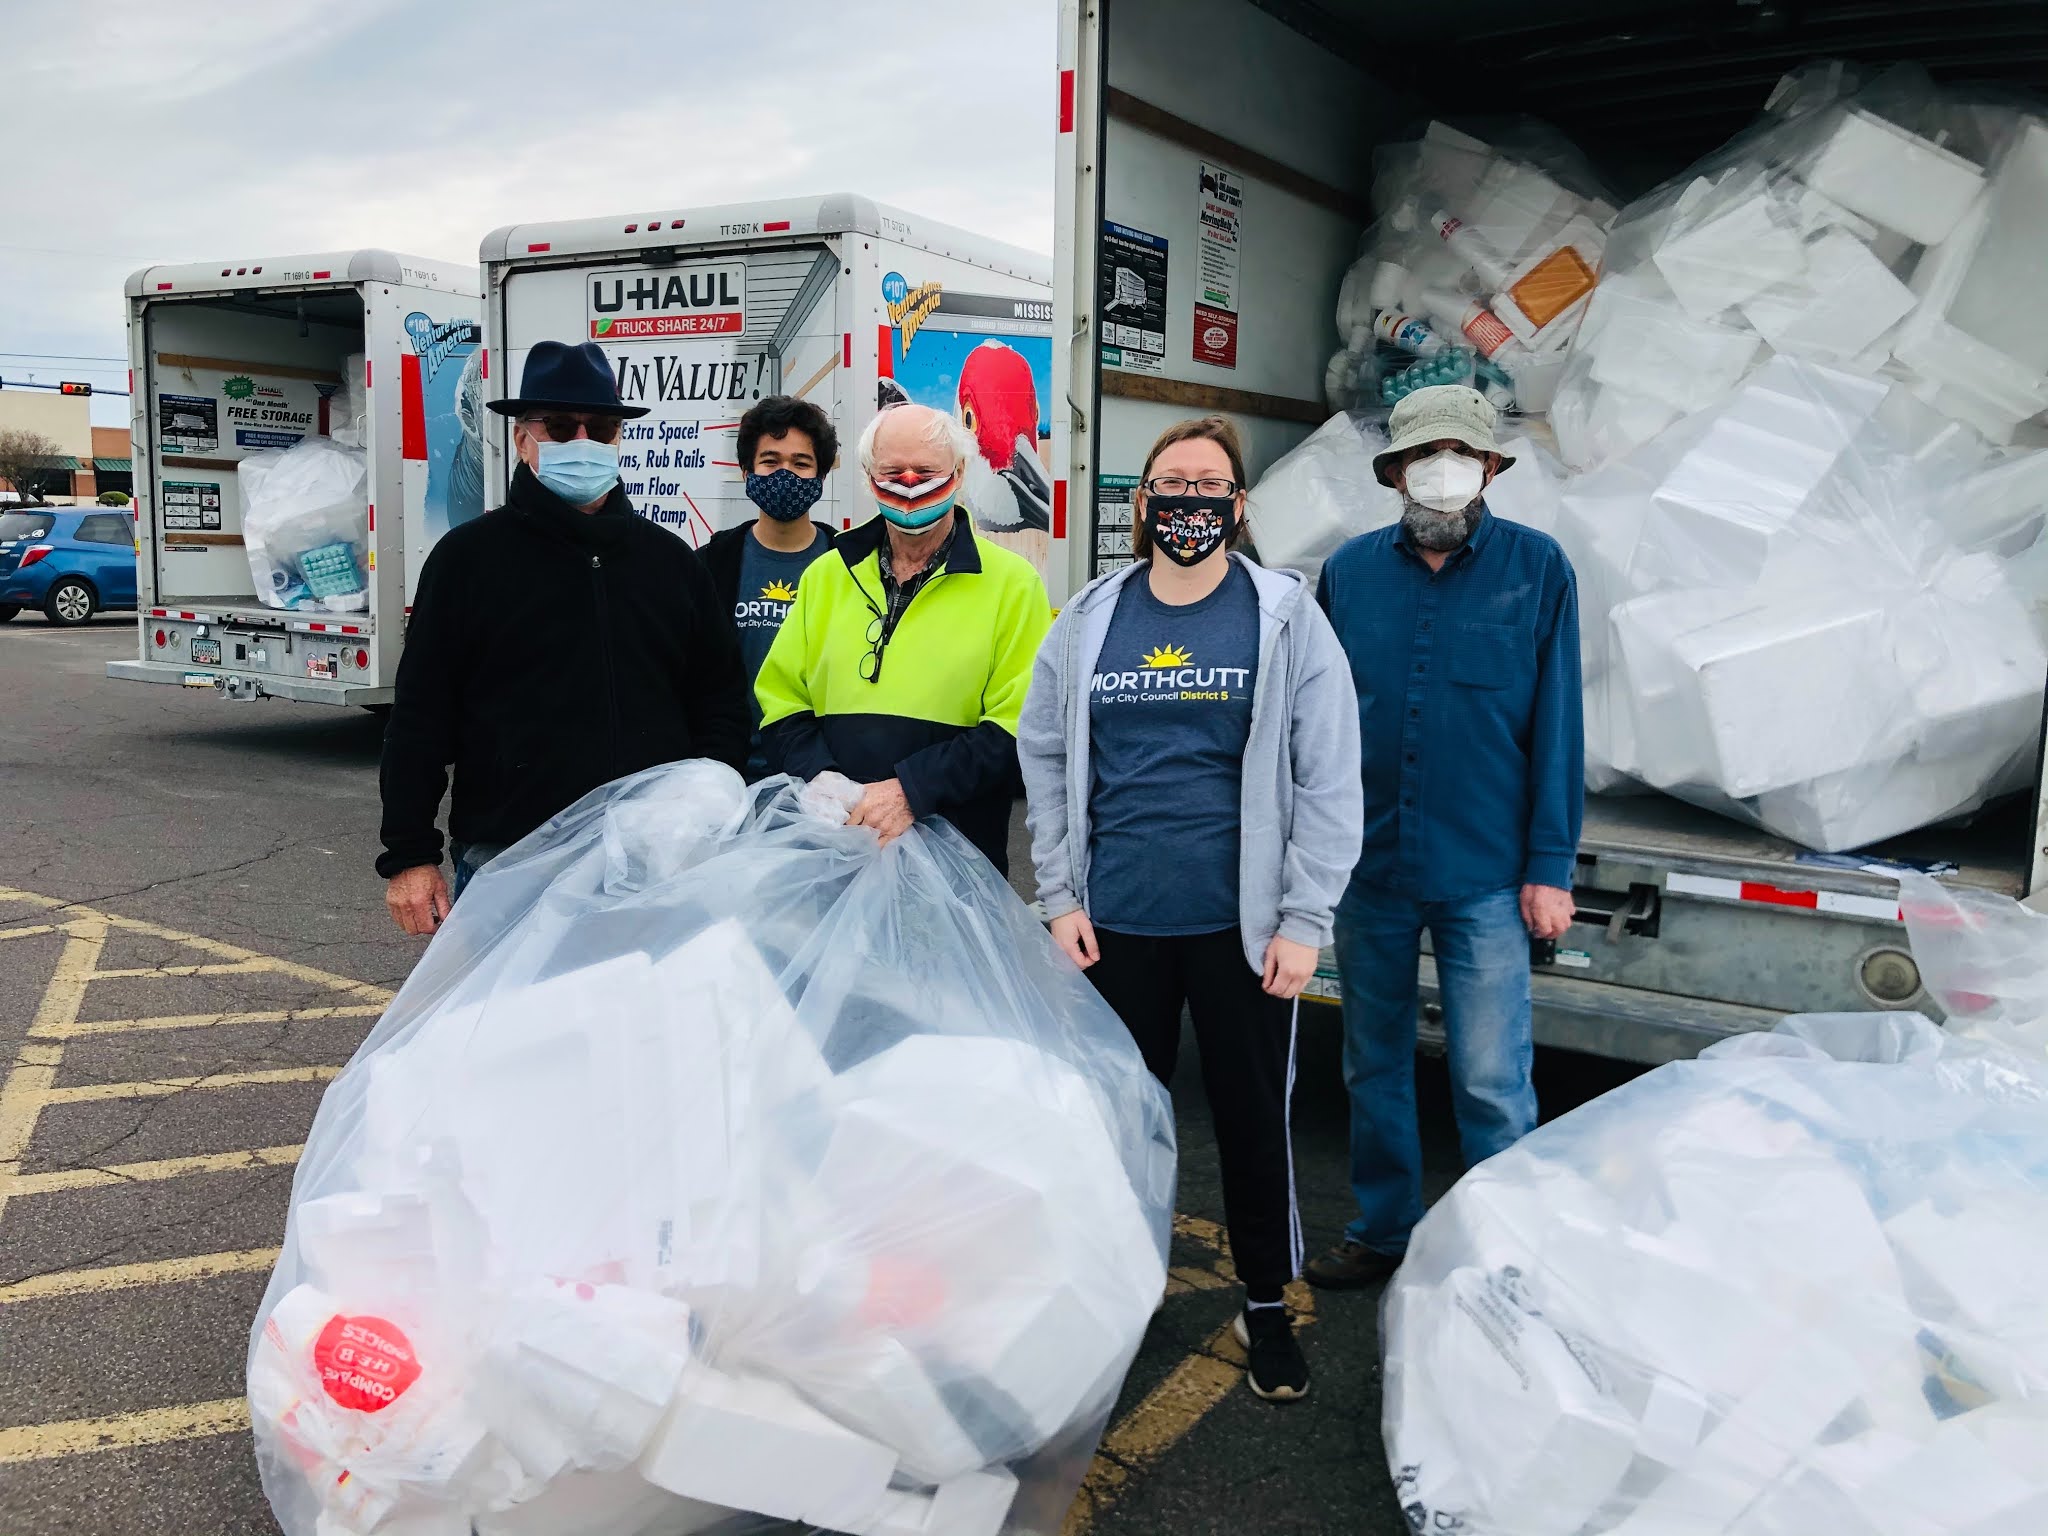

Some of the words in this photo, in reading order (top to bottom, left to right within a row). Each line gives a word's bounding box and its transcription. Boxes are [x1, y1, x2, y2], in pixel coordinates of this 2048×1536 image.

[720, 225, 731, 235] TT
[732, 223, 751, 234] 5787
[752, 222, 759, 233] K
[882, 217, 890, 228] TT
[891, 219, 905, 233] 5787
[905, 224, 912, 235] K
[284, 273, 291, 281] TT
[292, 271, 304, 280] 1691
[305, 271, 310, 279] G
[403, 268, 412, 278] TT
[414, 270, 430, 280] 1691
[431, 272, 438, 281] G
[594, 272, 740, 313] U-HAUL
[885, 280, 904, 298] #107
[887, 288, 922, 325] Venture
[408, 318, 430, 333] #108
[615, 320, 653, 334] TRUCK
[656, 318, 697, 333] SHARE
[700, 317, 726, 331] 24/7
[901, 293, 941, 361] America
[411, 323, 450, 353] Venture
[427, 326, 472, 382] America
[617, 356, 650, 400] IN
[257, 386, 283, 394] U-HAUL
[252, 399, 266, 407] One
[227, 406, 257, 419] FREE
[261, 409, 313, 424] STORAGE
[621, 421, 654, 440] Extra
[658, 420, 700, 445] Space!
[646, 448, 670, 468] Rub
[674, 448, 705, 468] Rails
[624, 482, 644, 495] um
[648, 476, 680, 496] Floor
[651, 504, 687, 529] Ramp
[1171, 525, 1210, 538] VEGAN
[734, 601, 794, 619] ORTH
[748, 619, 762, 628] City
[1101, 694, 1115, 704] for
[1117, 693, 1138, 704] City
[1140, 691, 1178, 702] Council
[1180, 690, 1218, 700] District
[1221, 690, 1229, 701] 5
